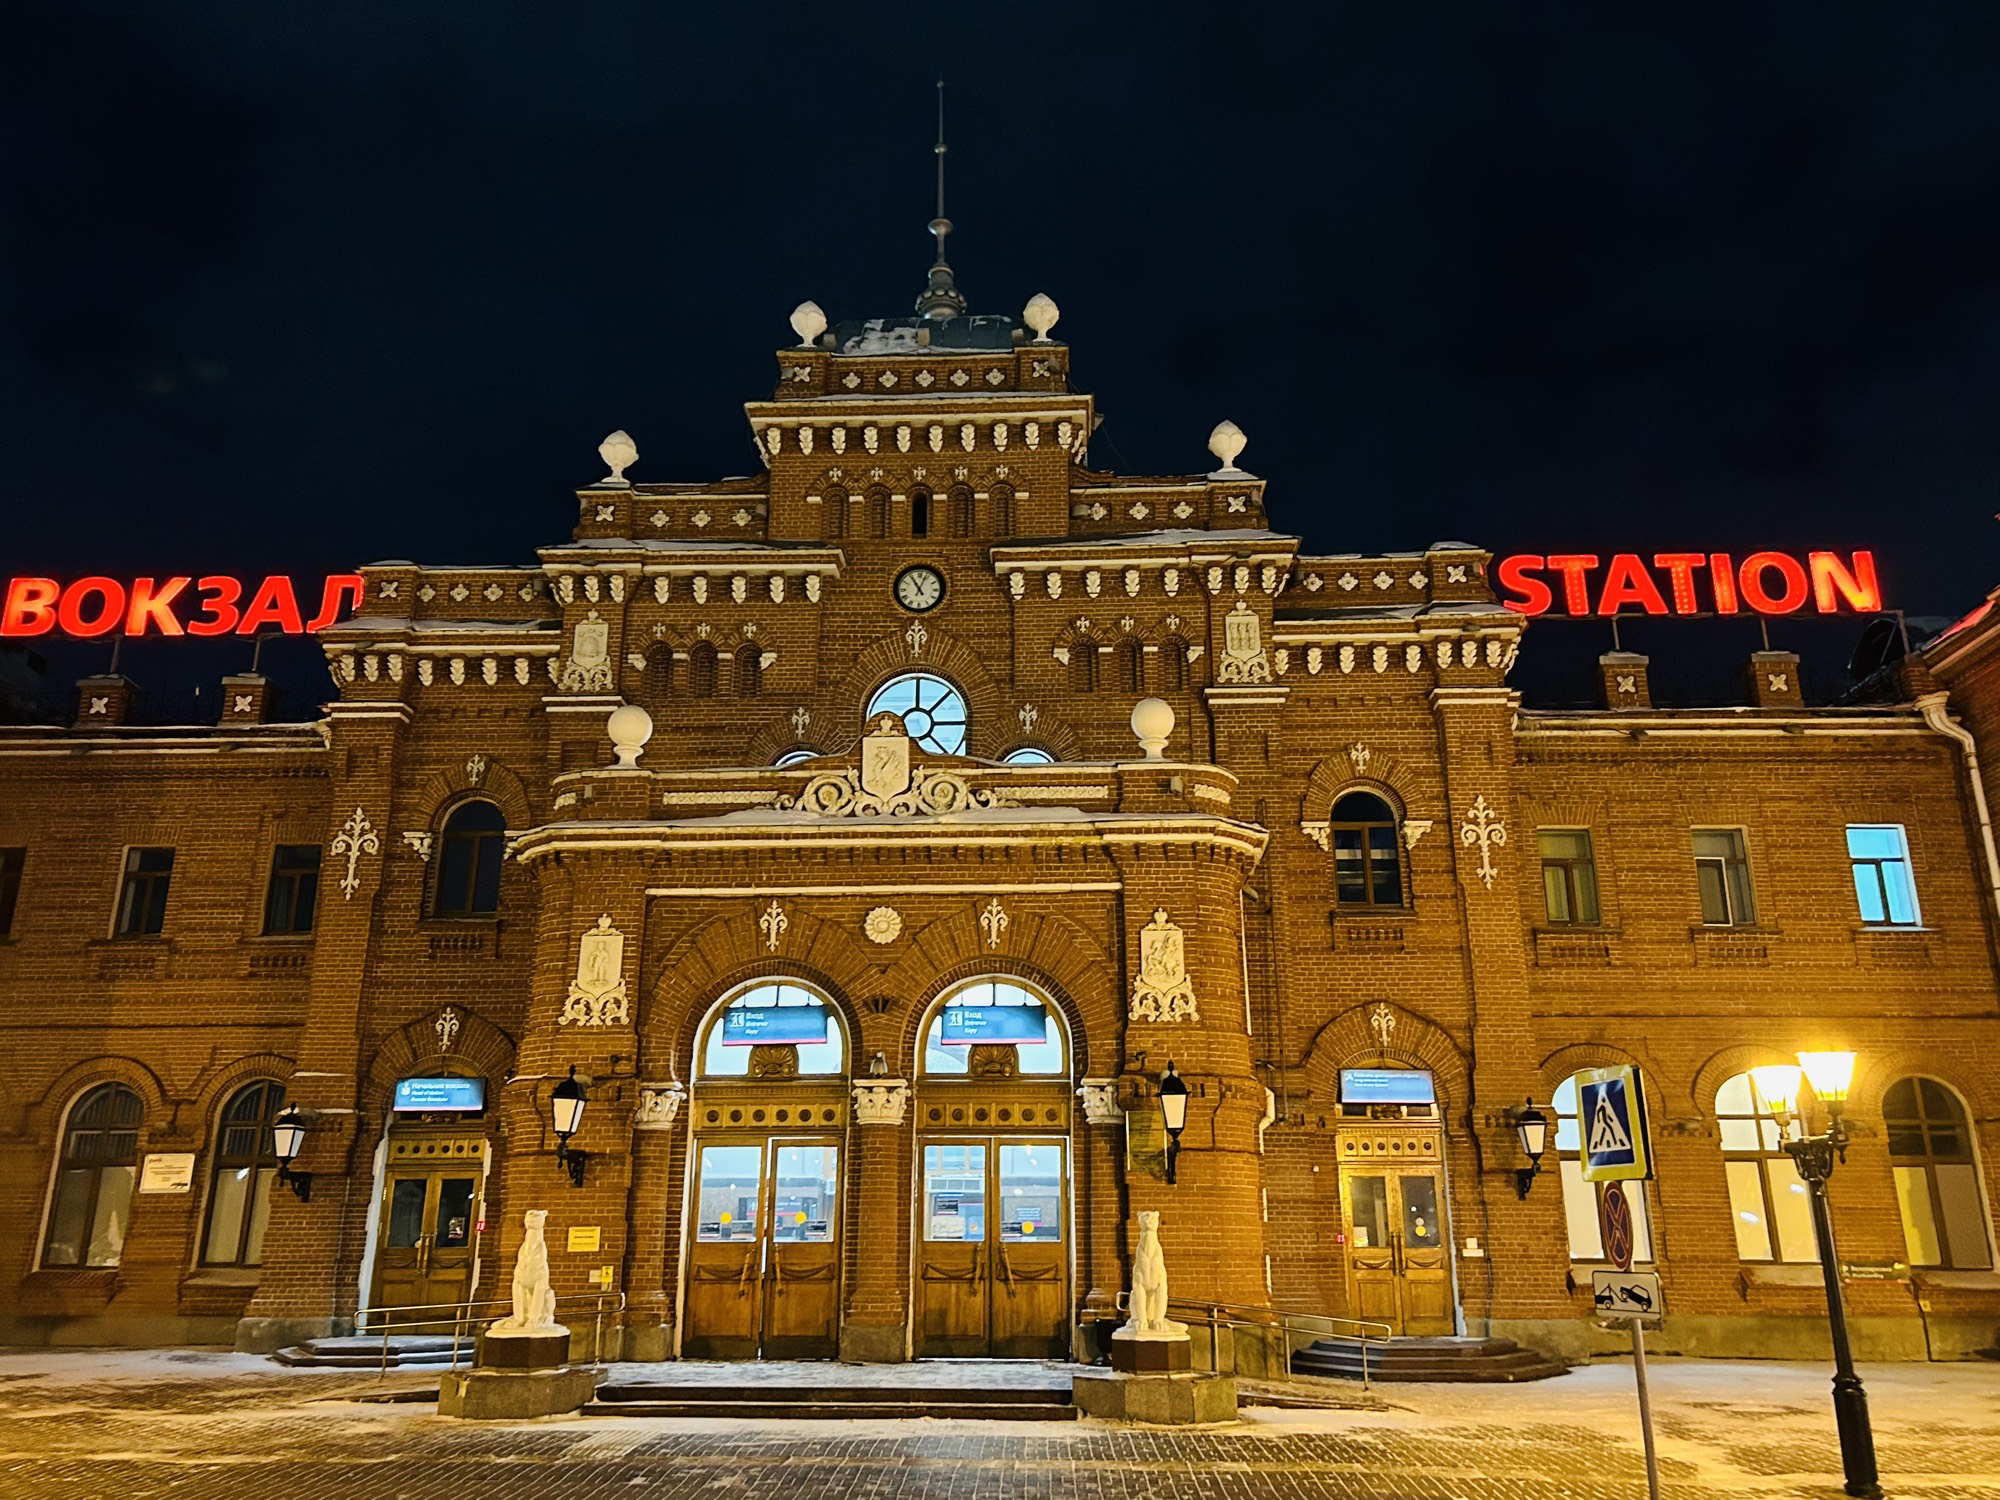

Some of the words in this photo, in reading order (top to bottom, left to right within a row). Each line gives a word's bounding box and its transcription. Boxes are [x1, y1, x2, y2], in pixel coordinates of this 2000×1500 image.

[1498, 551, 1881, 617] STATION
[0, 573, 365, 637] ВОКЗАЛ
[746, 1012, 764, 1020] Вход
[964, 1011, 982, 1019] Вход
